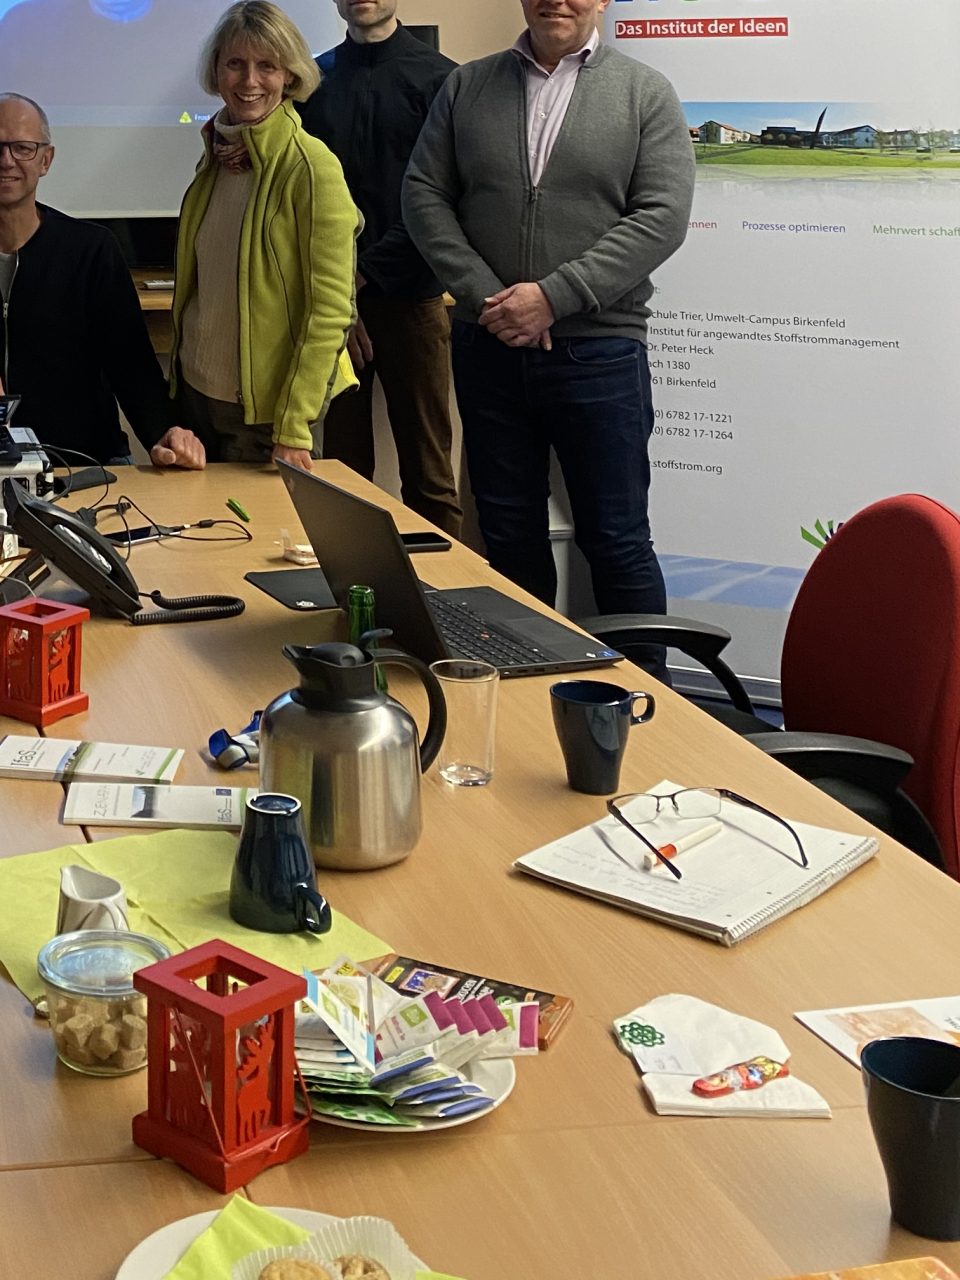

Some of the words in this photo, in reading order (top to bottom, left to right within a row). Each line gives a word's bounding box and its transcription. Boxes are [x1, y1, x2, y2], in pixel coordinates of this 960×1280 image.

[615, 22, 642, 36] Das
[646, 21, 704, 35] Institut
[707, 19, 736, 34] der
[739, 18, 787, 34] Ideen
[742, 220, 786, 231] Prozesse
[788, 222, 846, 234] optimieren
[872, 225, 926, 236] Mehrwert
[680, 311, 704, 322] Trier,
[706, 312, 791, 326] Umwelt-Campus
[793, 316, 846, 328] Birkenfeld
[650, 326, 685, 337] Institut
[687, 327, 701, 337] für
[703, 329, 772, 341] angewandtes
[773, 332, 900, 349] Stoffstrommanagement
[661, 343, 687, 353] Peter
[689, 345, 715, 355] Heck
[666, 360, 691, 370] 1380
[666, 376, 716, 389] Birkenfeld
[666, 410, 690, 420] 6782
[693, 412, 732, 423] 17-1221
[666, 427, 690, 437] 6782
[693, 429, 733, 440] 17-1264
